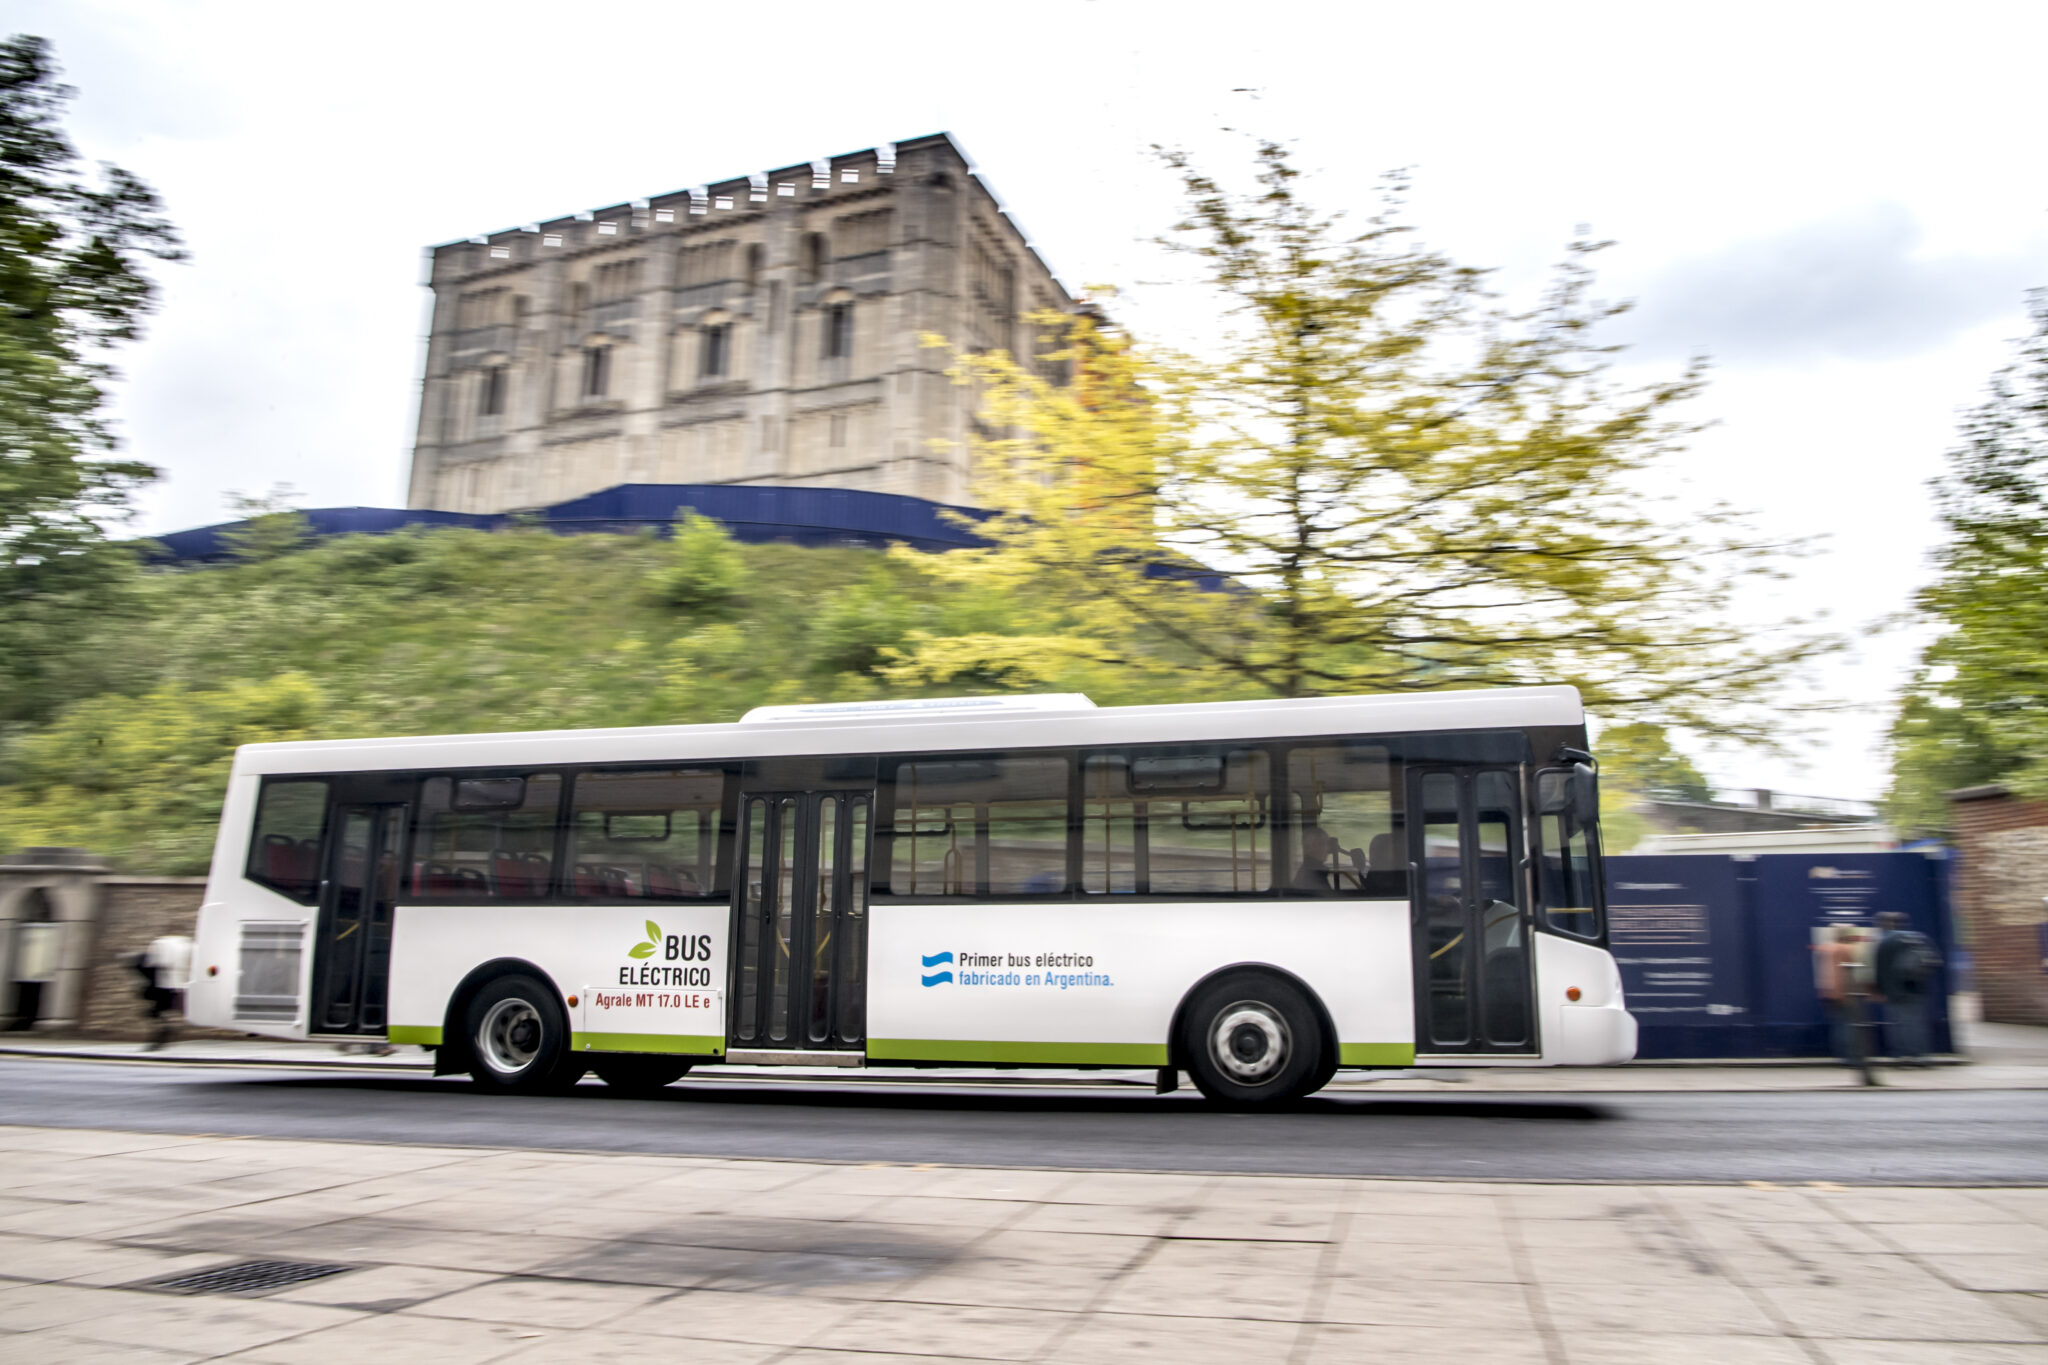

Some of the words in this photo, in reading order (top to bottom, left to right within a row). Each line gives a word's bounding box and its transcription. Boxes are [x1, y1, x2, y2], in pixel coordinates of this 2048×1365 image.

[665, 934, 712, 961] BUS
[959, 952, 1003, 967] Primer
[1008, 952, 1031, 967] bus
[1035, 952, 1094, 967] eléctrico
[619, 962, 711, 986] ELÉCTRICO
[959, 971, 1021, 985] fabricado
[1025, 974, 1040, 985] en
[1044, 971, 1114, 989] Argentina.
[596, 992, 632, 1010] Agrale
[636, 993, 654, 1008] MT
[658, 994, 681, 1009] 17.0
[685, 995, 700, 1008] LE
